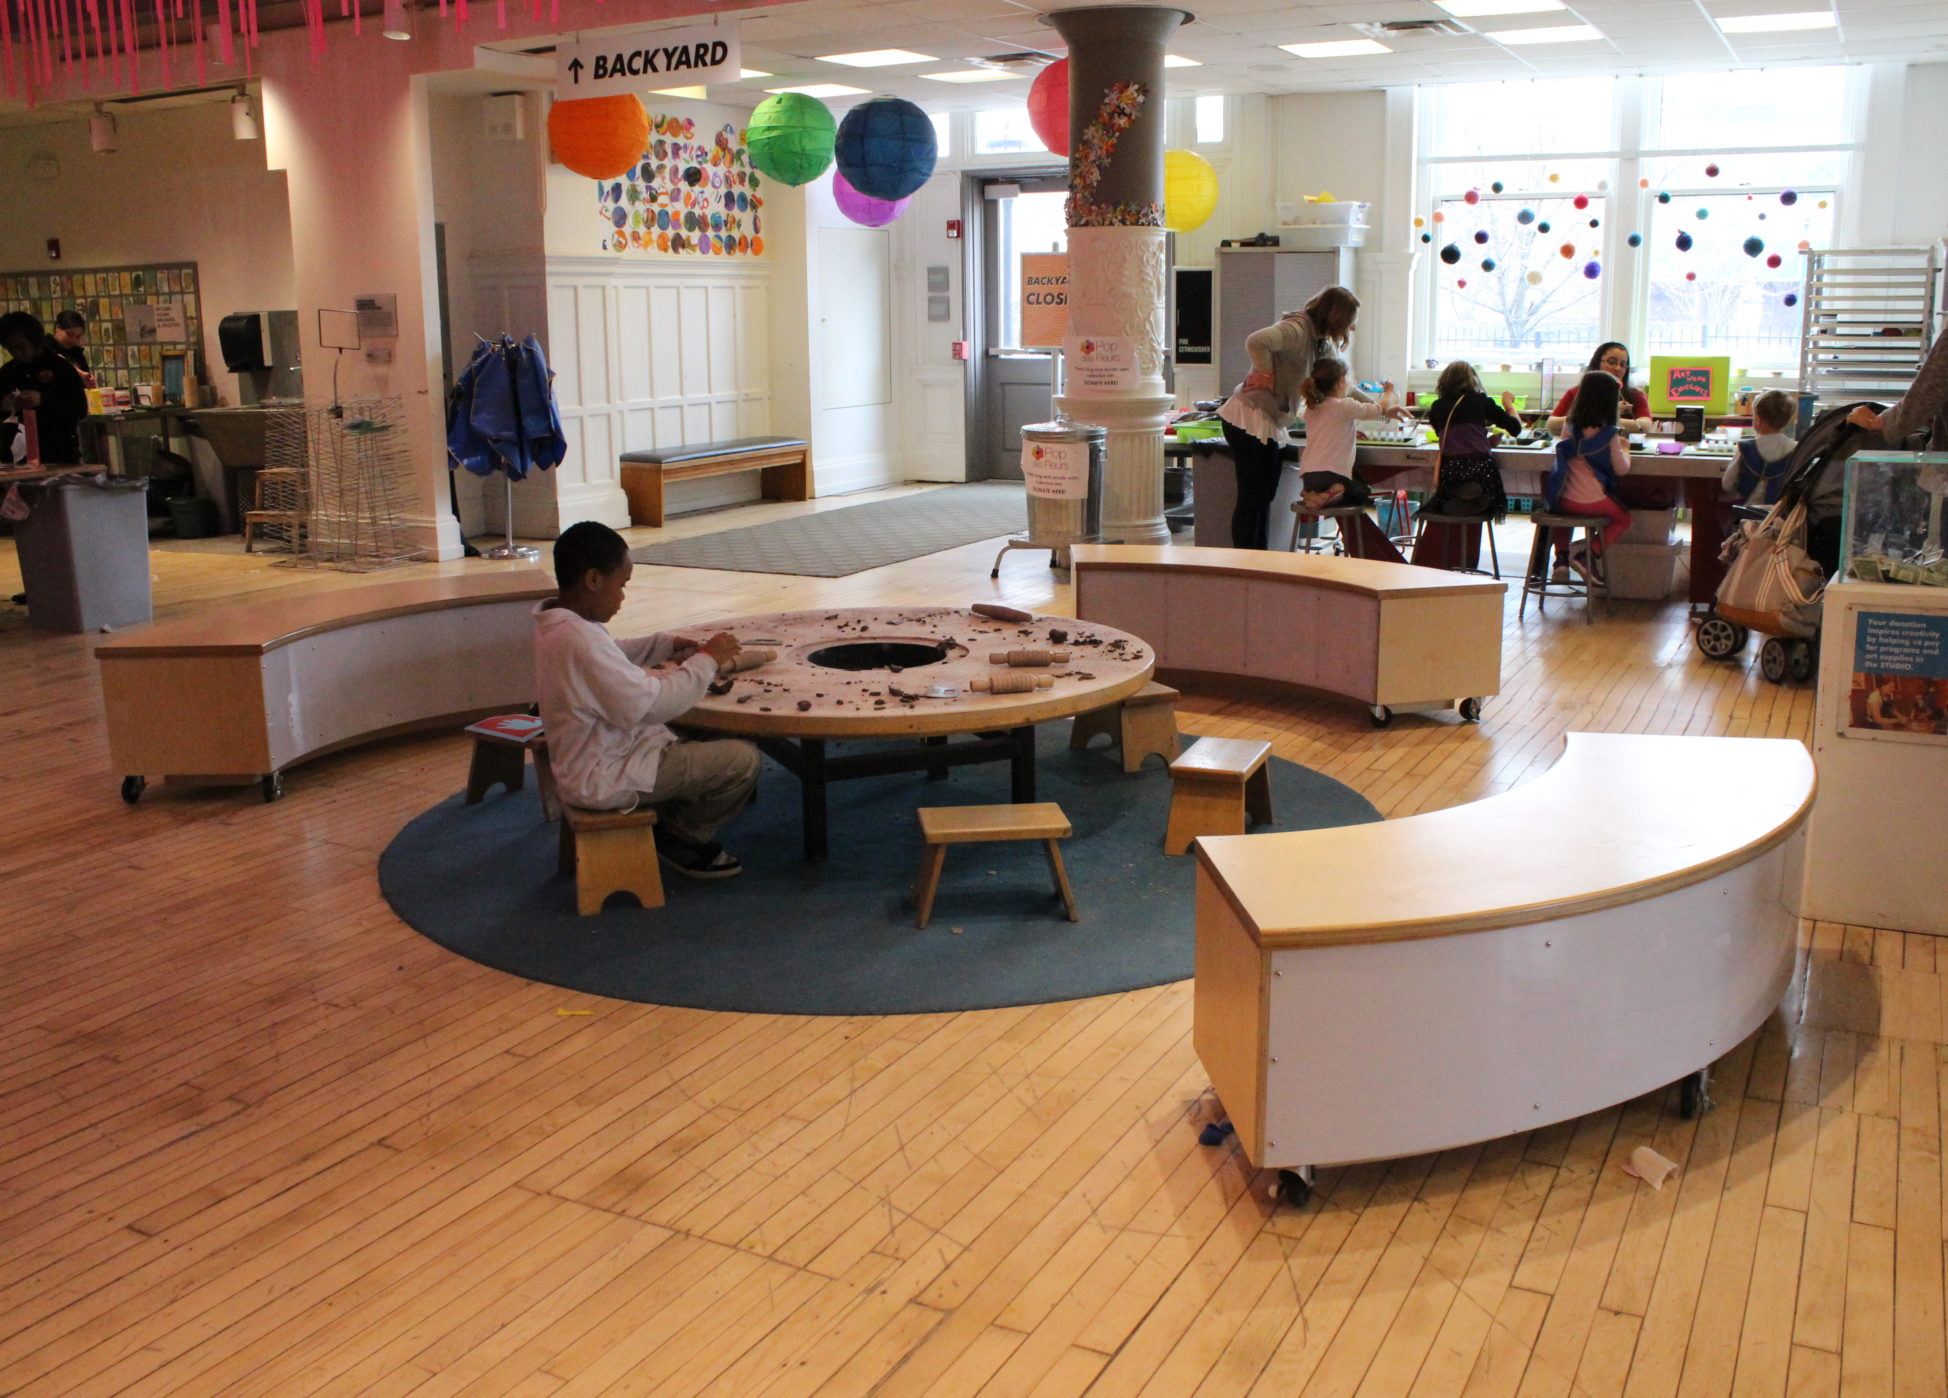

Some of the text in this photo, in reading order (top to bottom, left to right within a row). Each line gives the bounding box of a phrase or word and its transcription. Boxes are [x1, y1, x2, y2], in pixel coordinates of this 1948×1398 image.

[593, 40, 728, 80] BACKYARD
[1027, 276, 1068, 286] BACKYA
[1026, 292, 1068, 306] CLOS
[1095, 340, 1118, 353] Pop
[1178, 338, 1189, 346] FIRE
[1178, 345, 1211, 353] EXTINGUISHER
[1044, 446, 1068, 461] Pop
[1032, 486, 1067, 496] DONATE HERE!
[1867, 618, 1927, 629] Your donation
[1902, 630, 1940, 640] creativity
[1866, 635, 1940, 648] by helping us pay
[1865, 643, 1940, 656] for programs and
[1880, 654, 1914, 663] supplies
[1915, 656, 1924, 664] in
[1864, 661, 1915, 671] the STUDIO.
